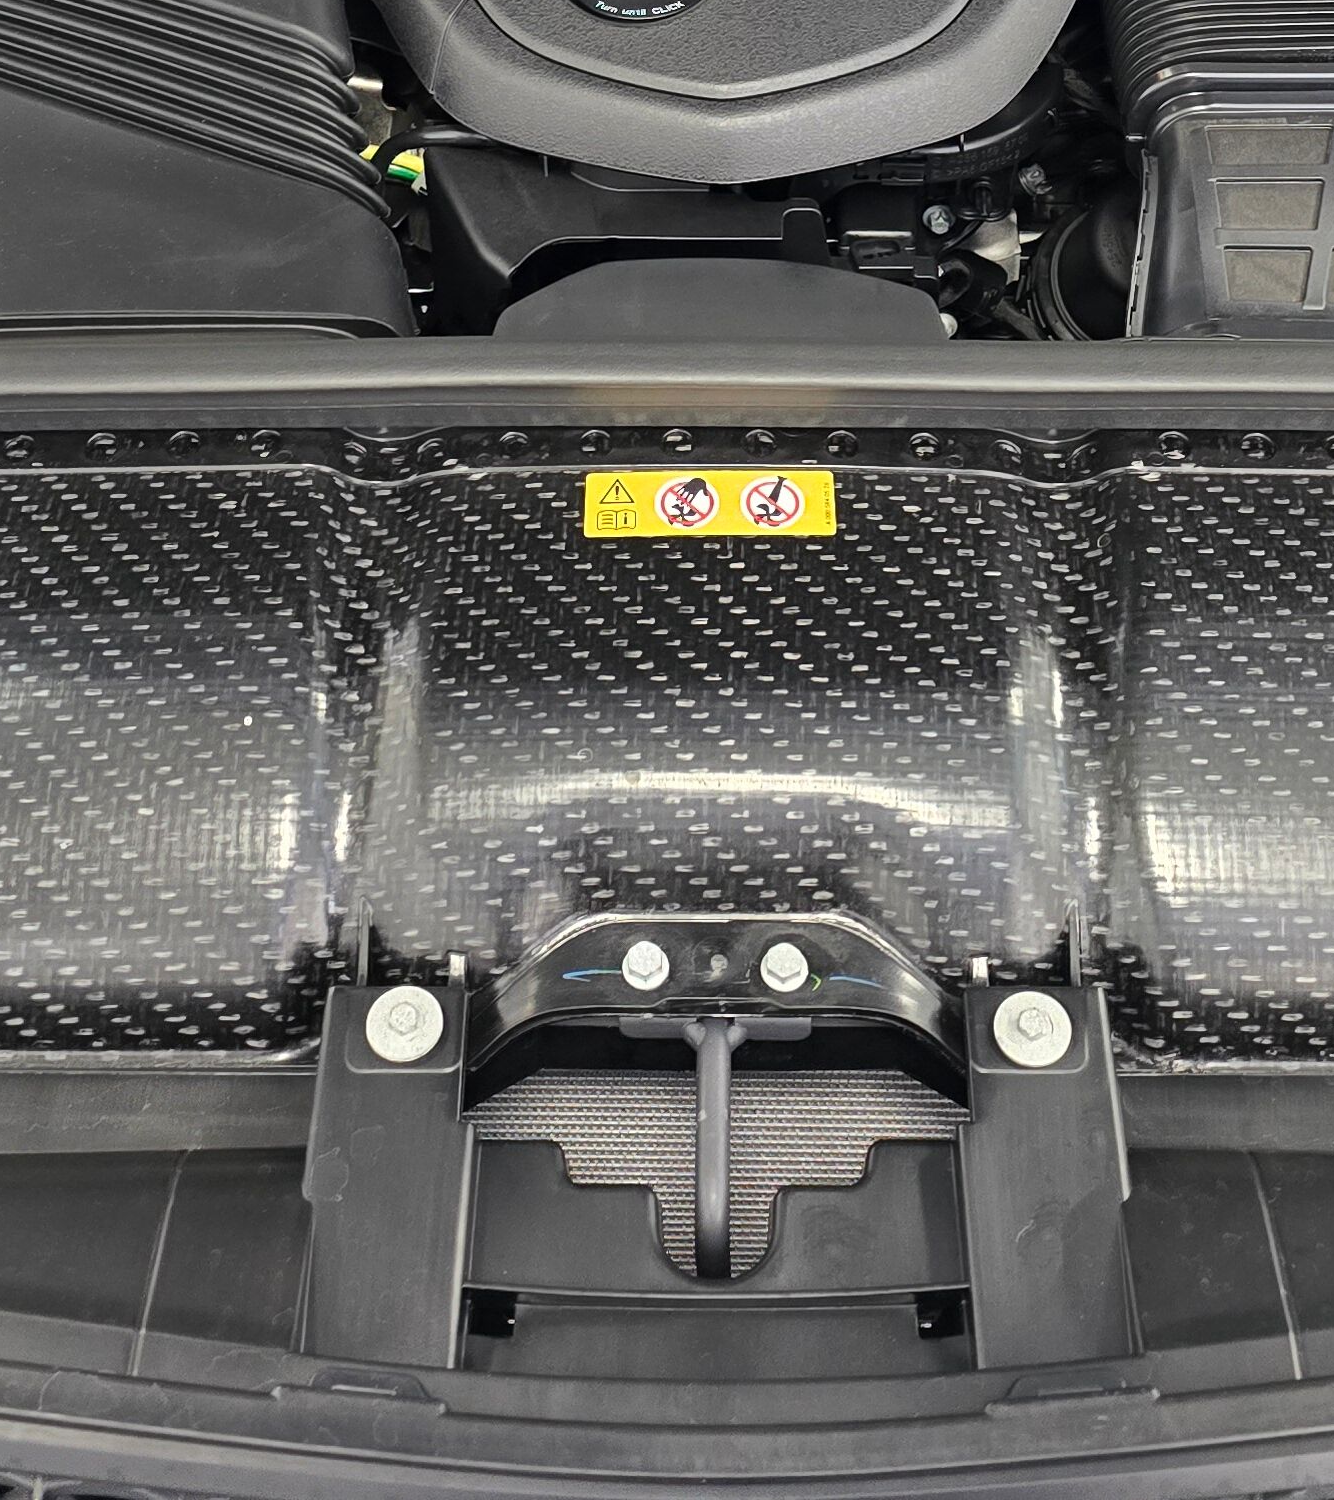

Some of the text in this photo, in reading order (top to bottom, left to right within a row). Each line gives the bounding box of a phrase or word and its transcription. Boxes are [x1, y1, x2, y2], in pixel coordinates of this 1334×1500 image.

[595, 0, 686, 16] Turn until CLICK
